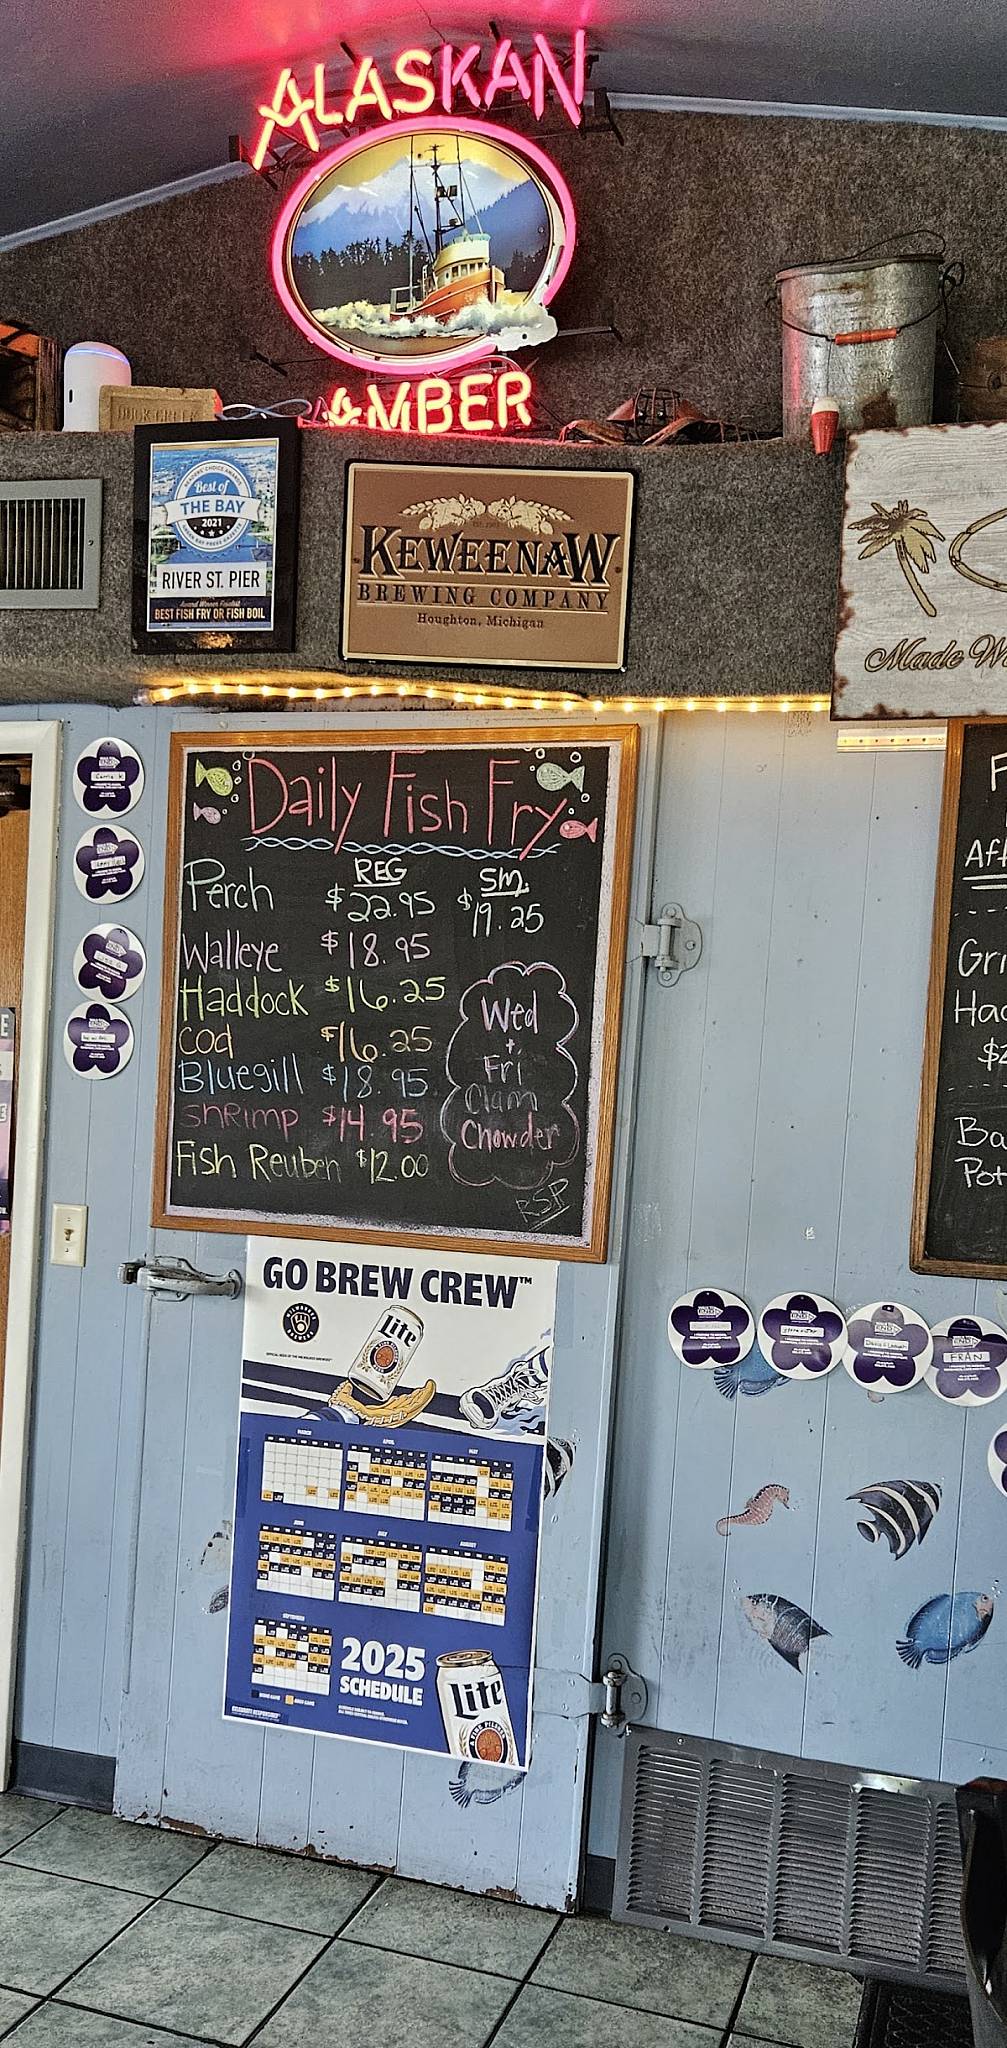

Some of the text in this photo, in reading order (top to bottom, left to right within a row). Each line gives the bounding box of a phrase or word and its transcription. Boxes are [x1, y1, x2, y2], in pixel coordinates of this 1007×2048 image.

[253, 29, 586, 171] ALASKAN
[324, 371, 533, 434] AMBER
[180, 500, 245, 515] THE BAY
[194, 480, 230, 494] Best of
[201, 518, 222, 527] 2021
[359, 525, 621, 587] KEWEENAW
[162, 570, 260, 590] RIVER ST. PIER
[357, 582, 609, 611] BREWING COMPANY
[154, 608, 266, 620] BEST FISH FRY OR FISH BOIL
[416, 612, 544, 629] Houghton, Michigan
[864, 638, 964, 673] Made
[246, 749, 568, 861] Daily Fish Fry
[354, 857, 408, 885] REG
[182, 858, 545, 938] Perch $22.95 $19.25
[182, 929, 432, 974] Walleye $18.95
[180, 972, 447, 1022] Haddock $16.25
[480, 990, 539, 1034] Wed
[320, 1020, 434, 1063] $16.25
[178, 1052, 429, 1102] Bluegill $18.95
[483, 1047, 522, 1086] Fri
[464, 1082, 538, 1115] Clam
[322, 1103, 424, 1144] $14.95
[460, 1111, 561, 1154] Chowder
[176, 1140, 429, 1185] Fish Reuben $12.00
[515, 1177, 570, 1224] RSP
[263, 1256, 308, 1291] GO
[315, 1260, 413, 1300] BREW
[378, 1314, 416, 1348] Lite
[950, 1352, 983, 1362] FRAN
[341, 1636, 426, 1682] 2025
[340, 1674, 424, 1706] SCHEDULE
[448, 1680, 502, 1720] Lite
